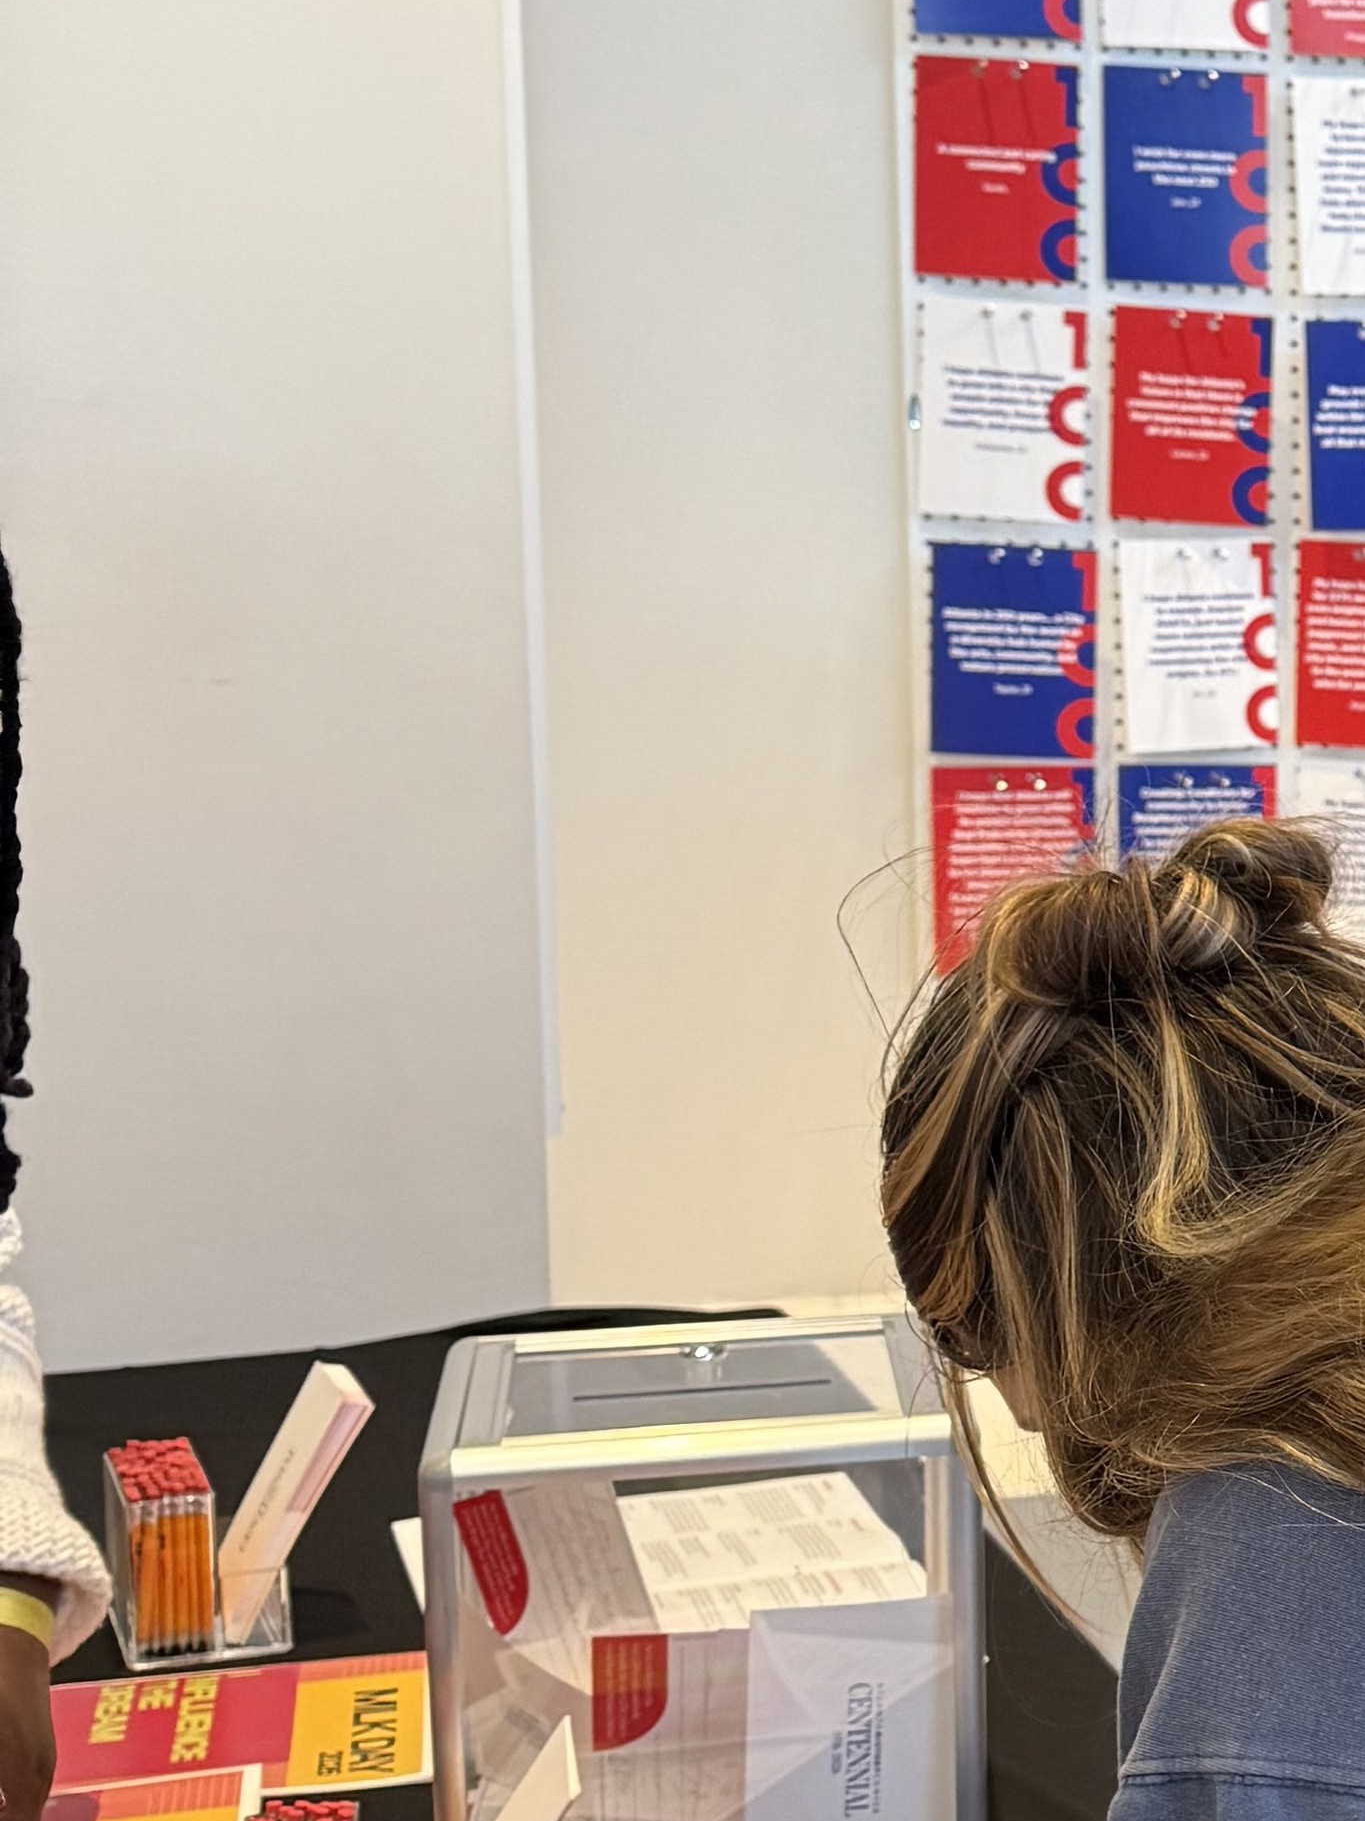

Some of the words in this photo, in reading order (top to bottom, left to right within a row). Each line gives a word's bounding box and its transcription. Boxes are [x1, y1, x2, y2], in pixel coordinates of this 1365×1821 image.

[352, 1687, 398, 1738] MLK
[348, 1736, 395, 1773] DAY
[845, 1682, 873, 1818] CENTENNIAL
